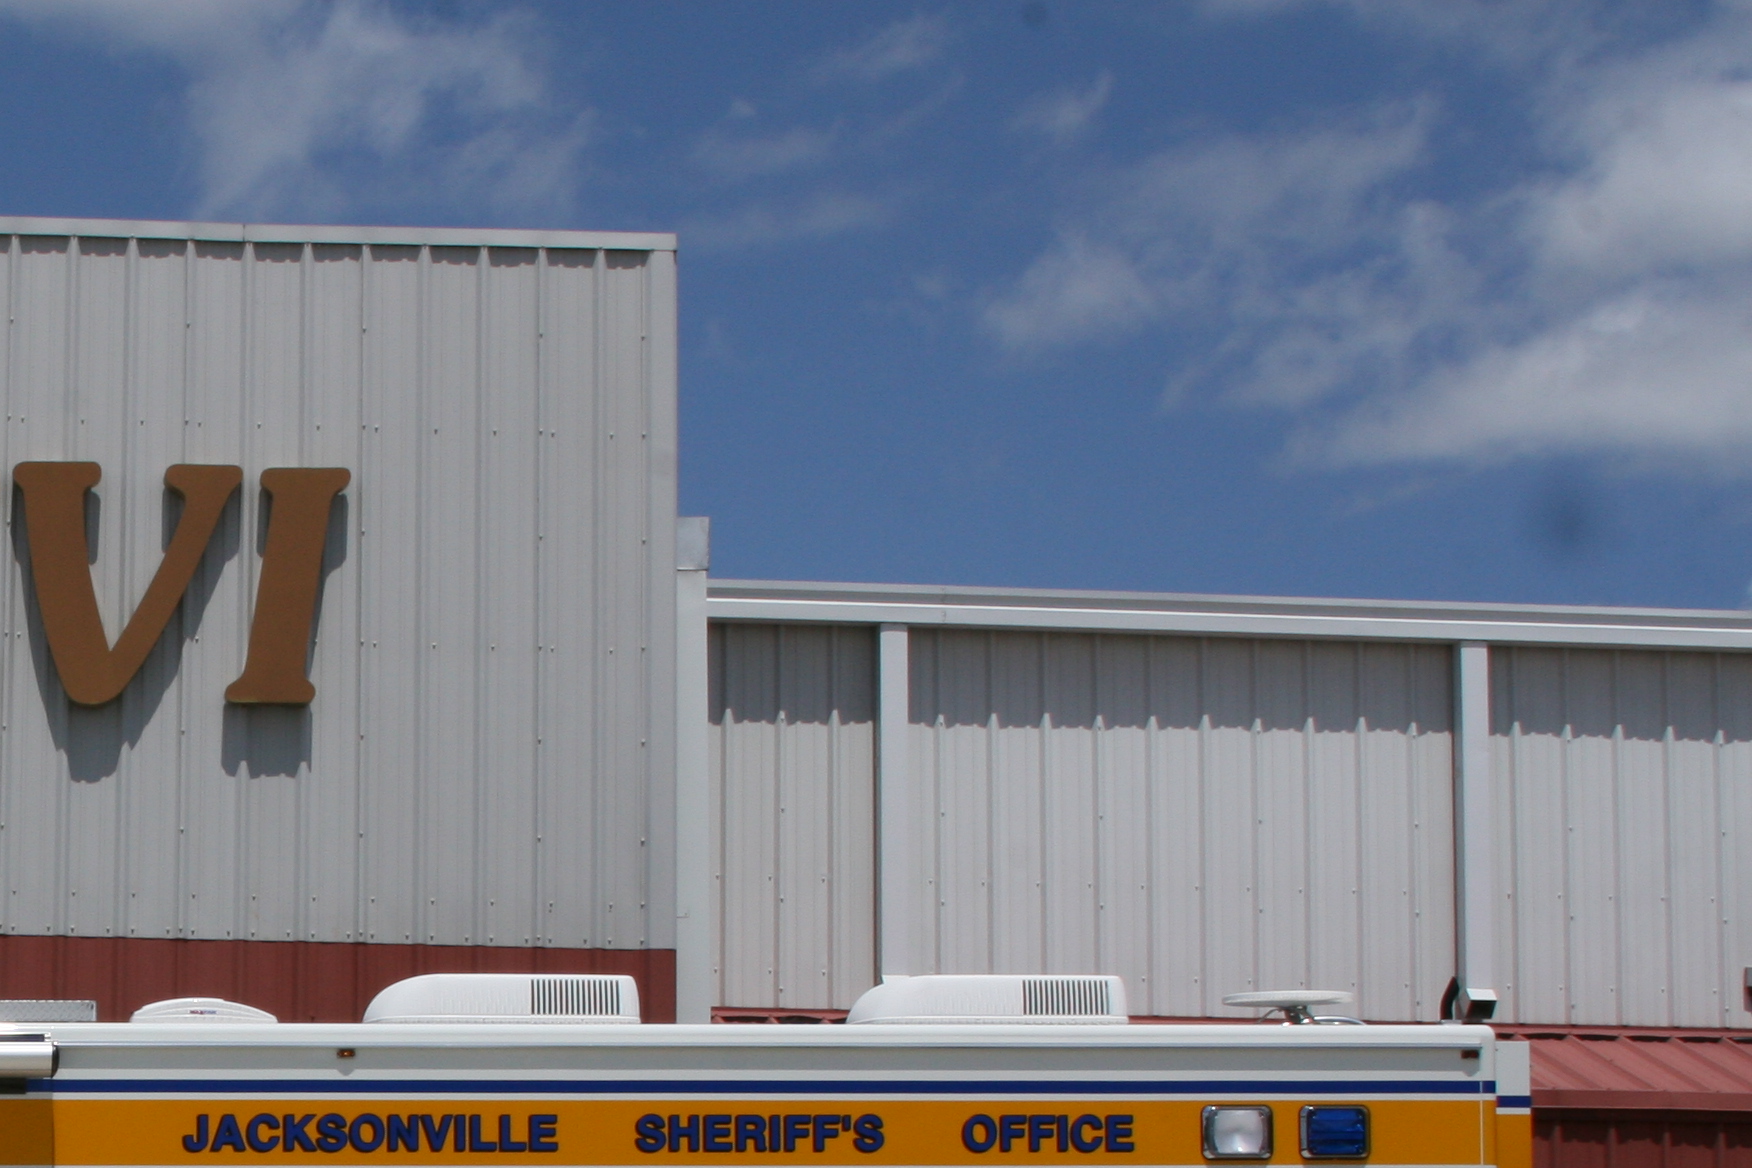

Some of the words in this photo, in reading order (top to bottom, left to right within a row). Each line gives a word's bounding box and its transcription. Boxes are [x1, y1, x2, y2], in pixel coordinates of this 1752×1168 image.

[181, 1113, 559, 1154] JACKSONVILLE
[634, 1113, 885, 1154] SHERIFF'S
[960, 1113, 1135, 1154] OFFICE
